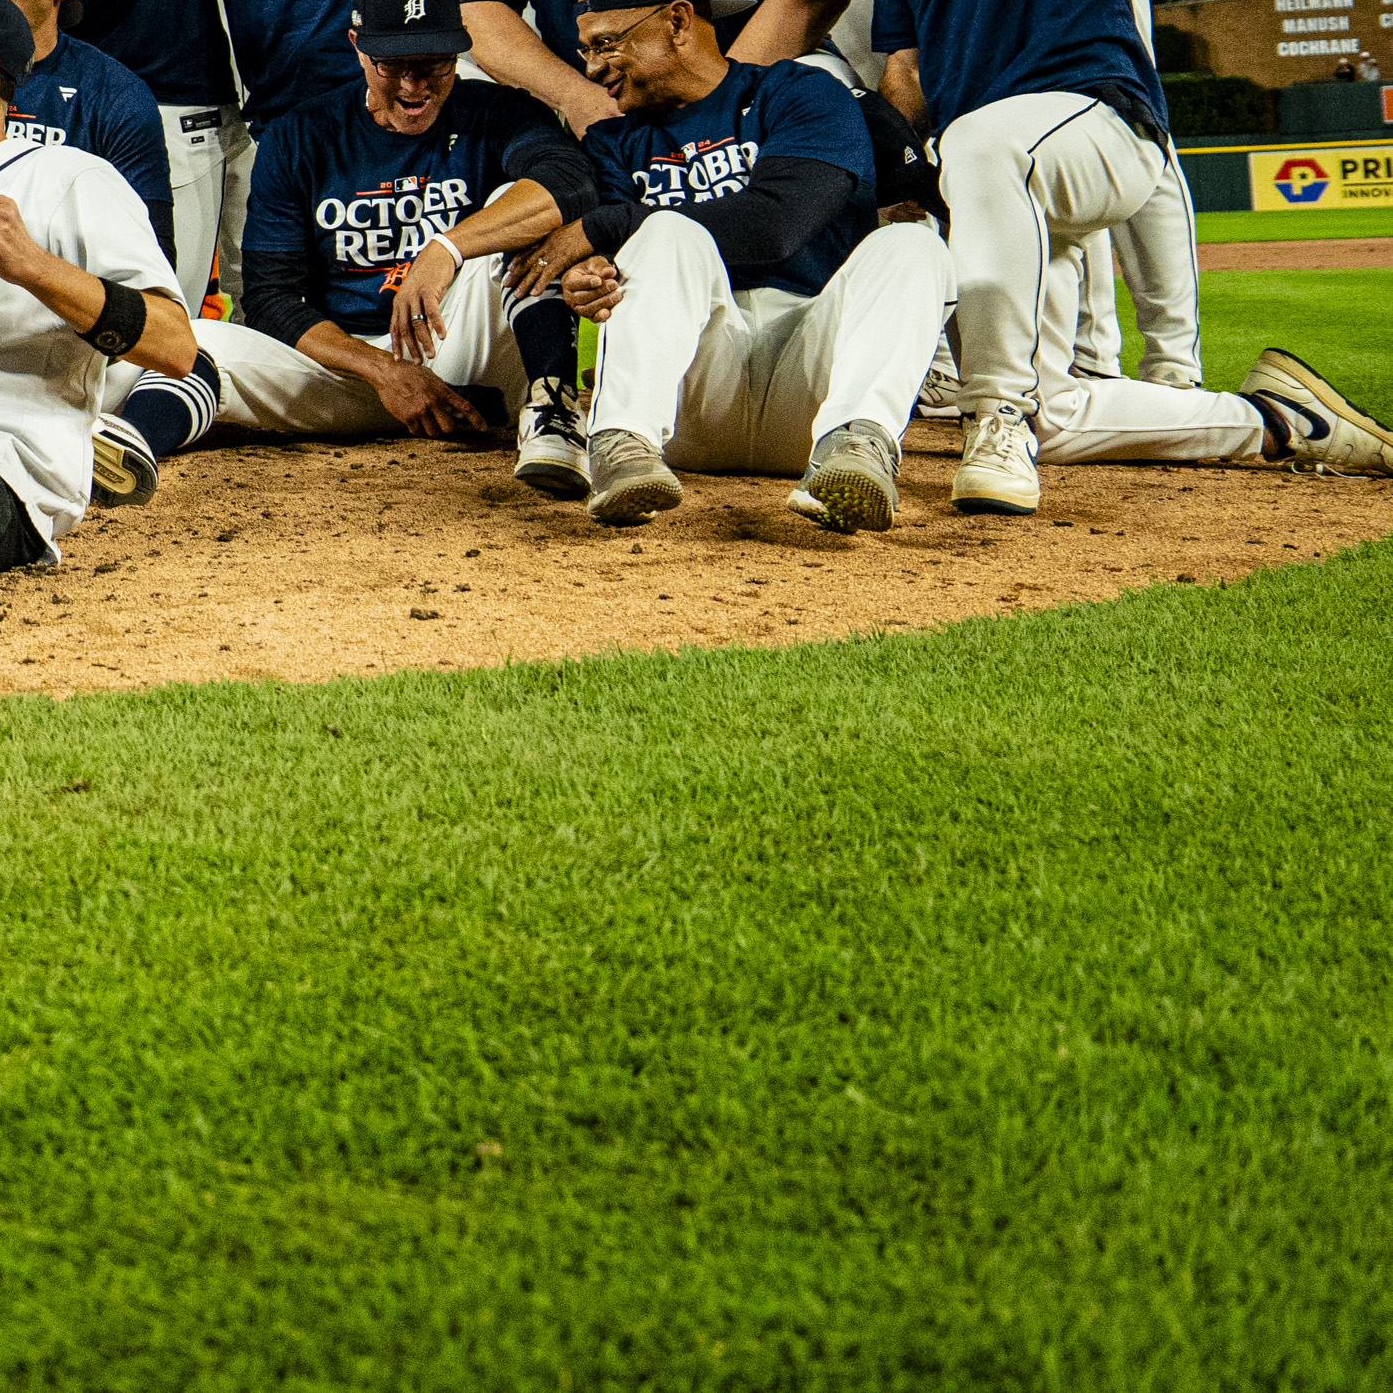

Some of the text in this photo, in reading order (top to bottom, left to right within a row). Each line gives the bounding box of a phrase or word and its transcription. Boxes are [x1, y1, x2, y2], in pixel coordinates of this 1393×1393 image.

[1283, 16, 1349, 33] MANUSH
[1277, 39, 1360, 56] COCHRANE
[315, 178, 473, 231] OCTOER
